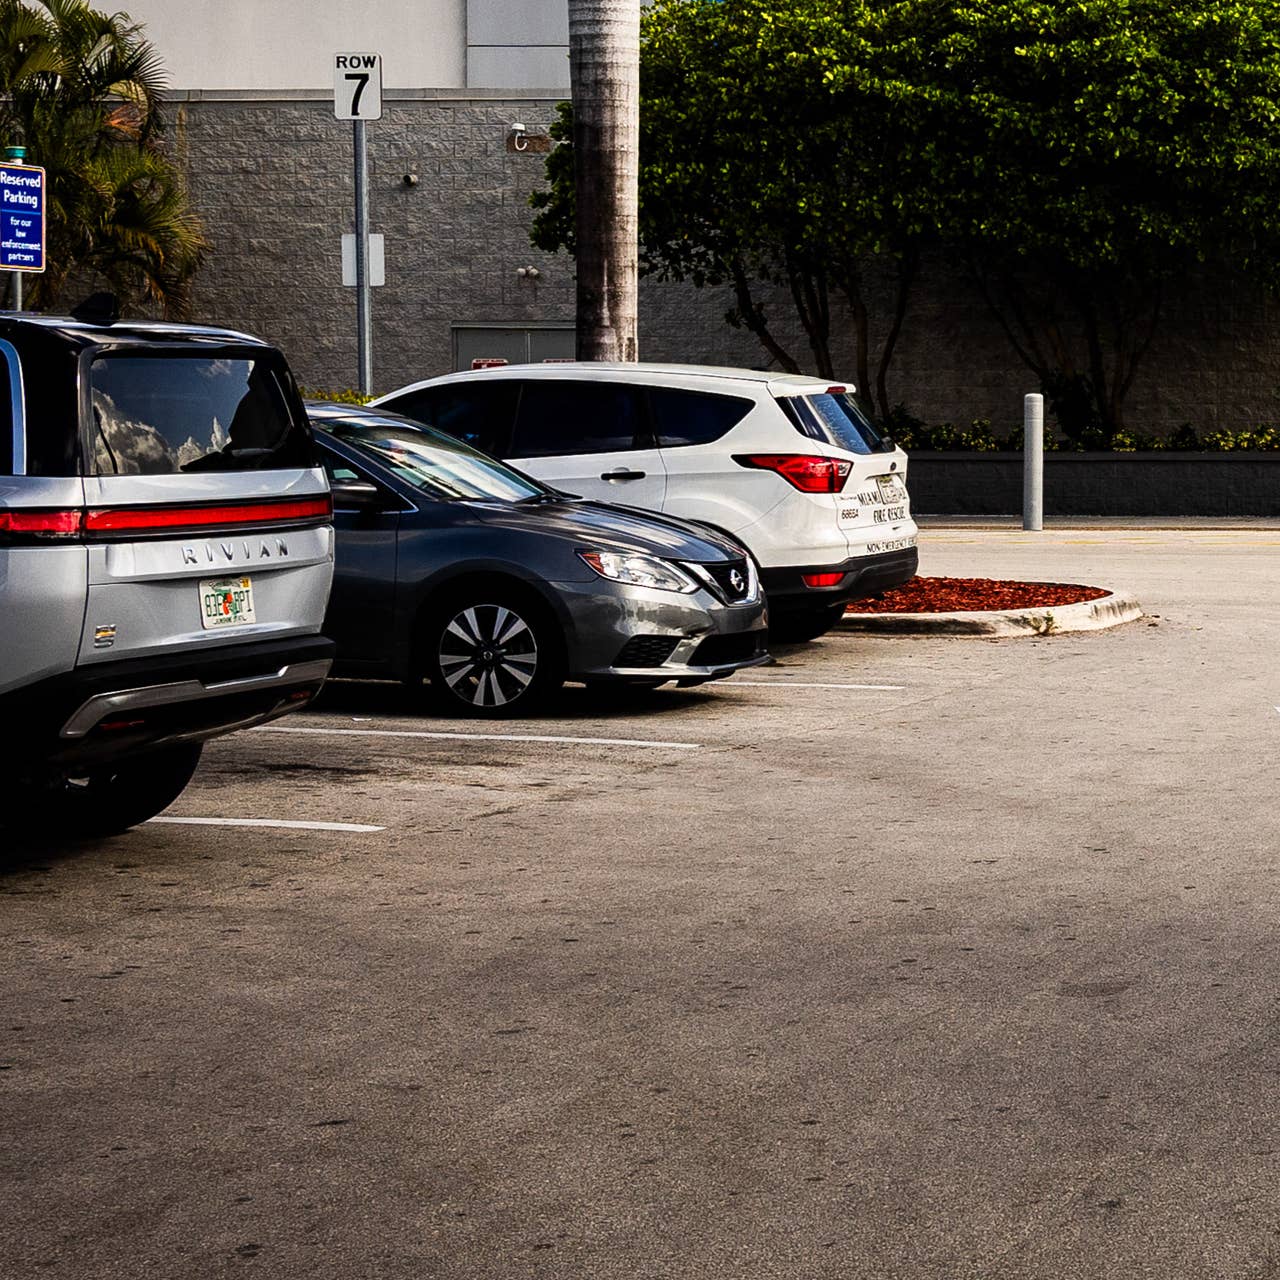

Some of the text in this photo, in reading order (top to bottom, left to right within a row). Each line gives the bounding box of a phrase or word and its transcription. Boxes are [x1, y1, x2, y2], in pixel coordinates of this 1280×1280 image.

[336, 56, 376, 69] ROW
[345, 73, 369, 116] 7
[0, 171, 41, 188] Reserved
[4, 189, 38, 208] Parking
[10, 216, 32, 227] for our
[15, 228, 26, 238] law
[1, 239, 41, 251] enforcement
[8, 253, 34, 262] partners
[181, 538, 288, 564] RIVIAN
